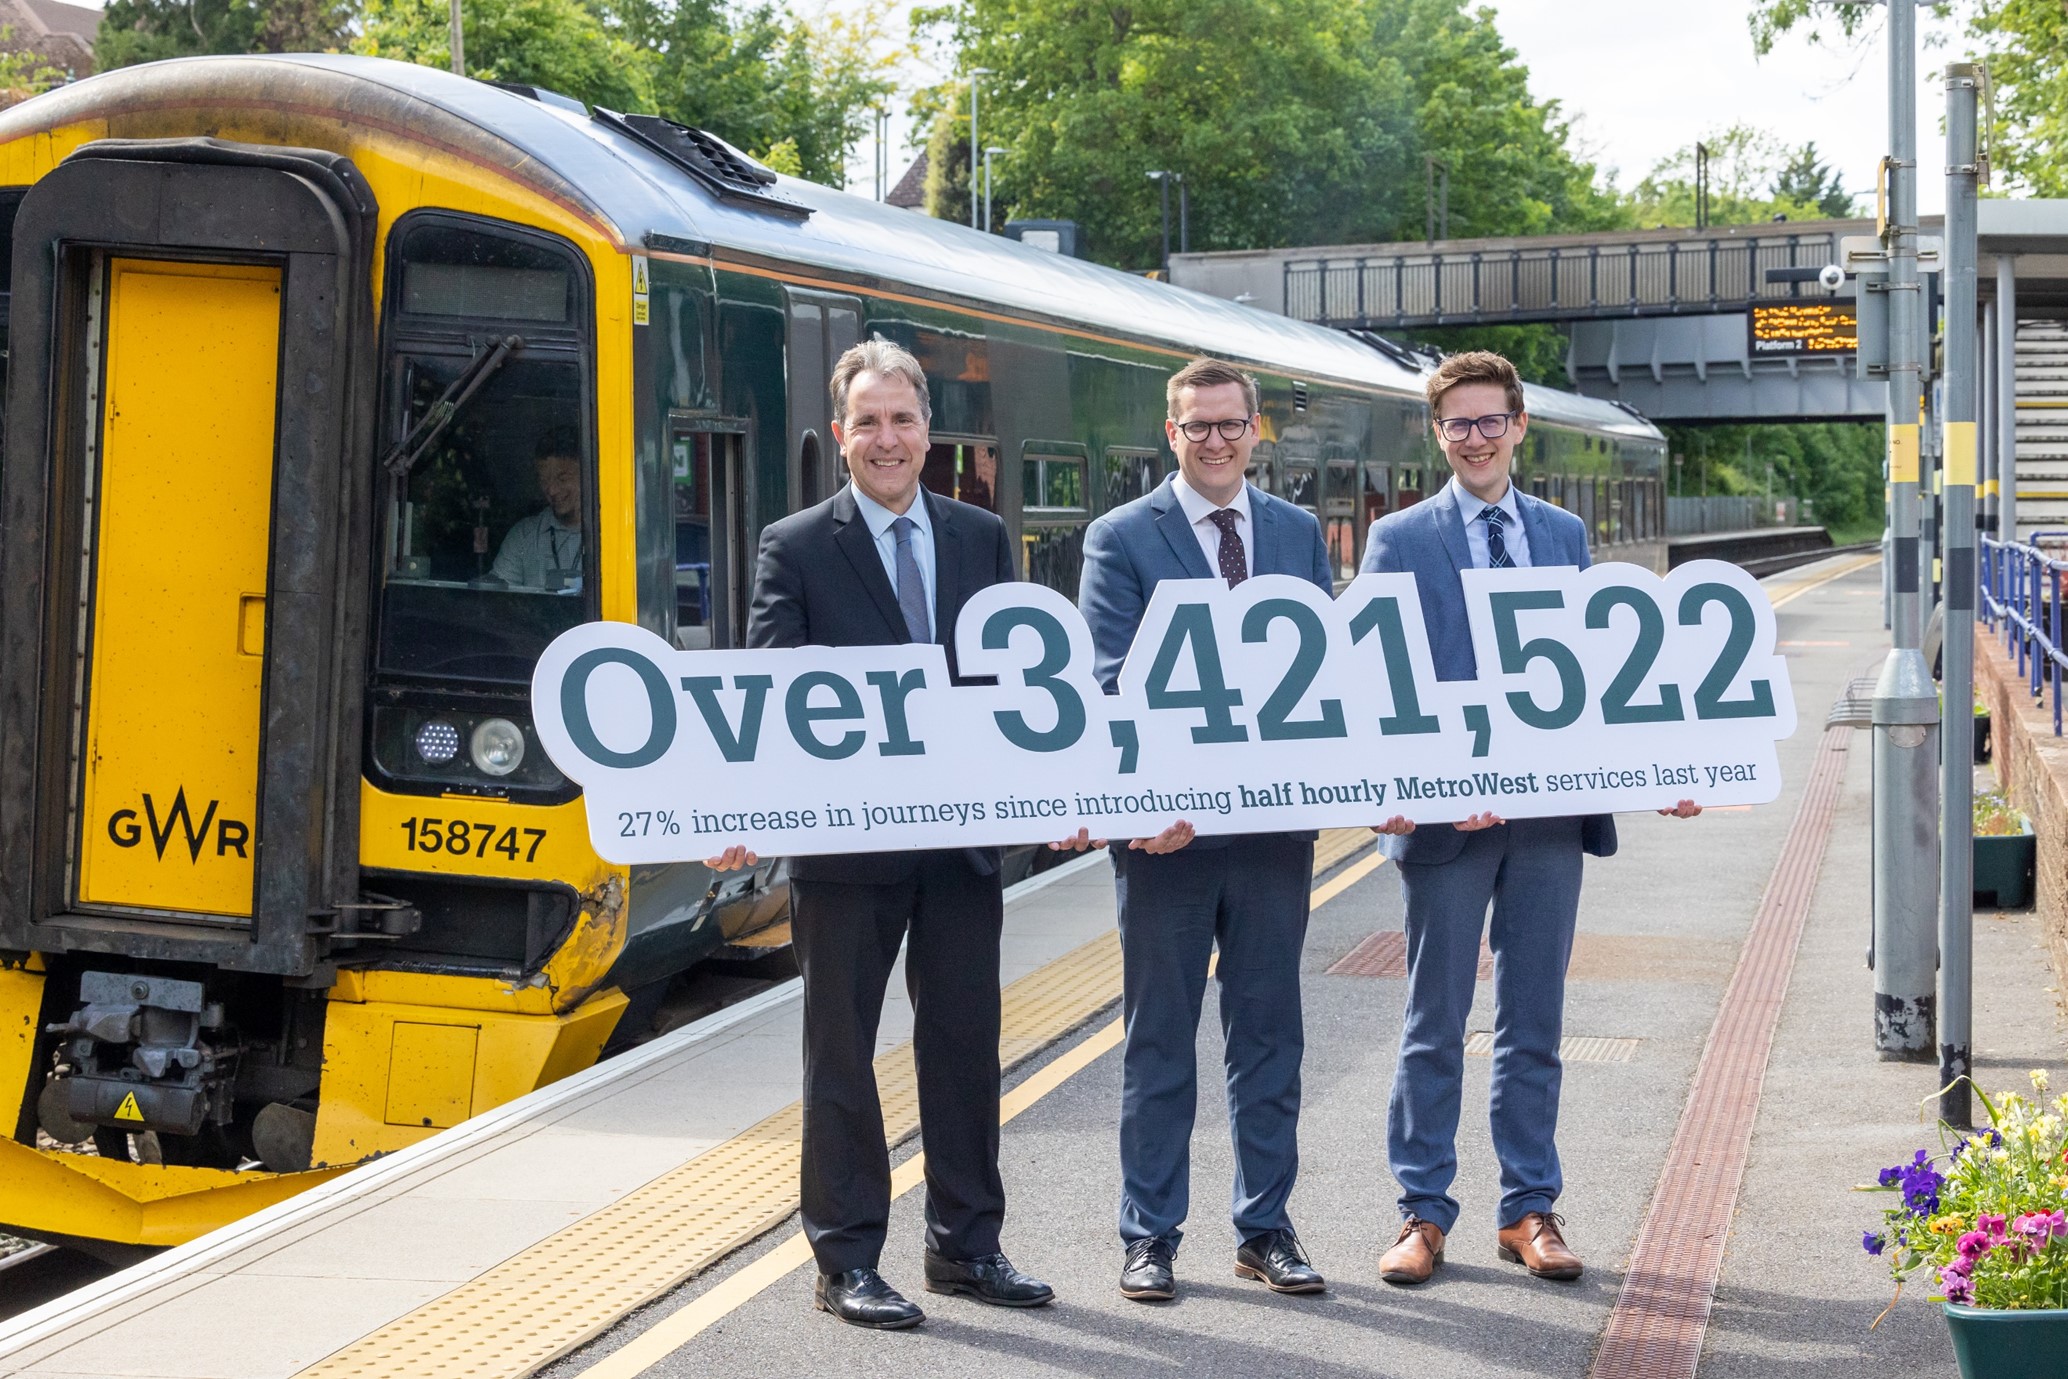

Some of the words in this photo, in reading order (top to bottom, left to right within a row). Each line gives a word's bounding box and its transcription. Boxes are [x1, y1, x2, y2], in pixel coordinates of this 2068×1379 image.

[1755, 340, 1795, 351] Platform
[1796, 339, 1803, 350] 2
[561, 648, 926, 768] Over
[982, 583, 1777, 774] 3,421,522
[107, 785, 250, 865] GWR
[619, 811, 681, 837] 27%
[692, 809, 817, 834] increase
[826, 803, 856, 828] in
[862, 801, 986, 831] journeys
[995, 797, 1067, 821] since
[1075, 788, 1232, 816] introducing
[1238, 781, 1294, 808] half
[1299, 779, 1387, 808] hourly
[1394, 771, 1540, 801] MetroWest
[1547, 767, 1647, 792] services
[1653, 763, 1699, 786] last
[1704, 763, 1757, 788] year
[401, 817, 547, 863] 158747
